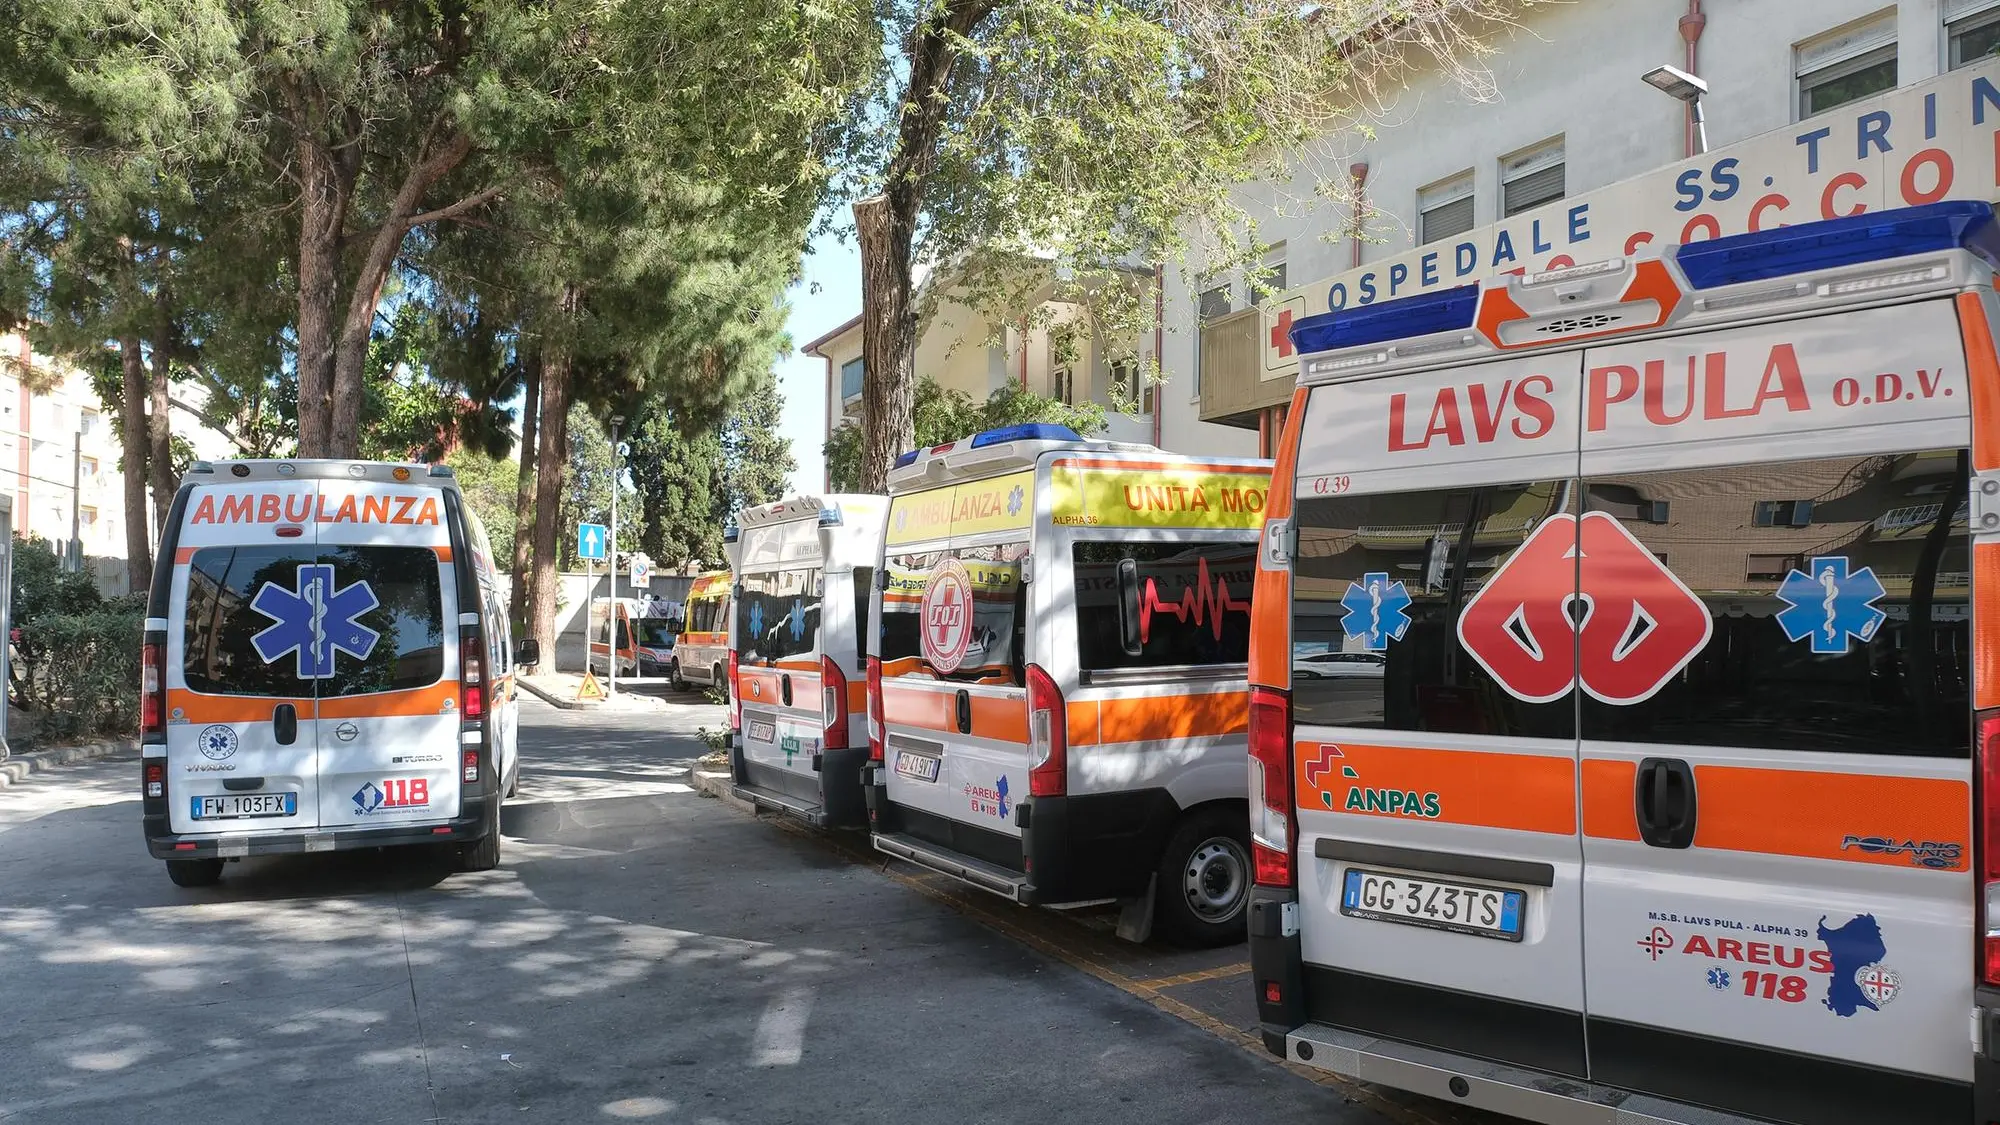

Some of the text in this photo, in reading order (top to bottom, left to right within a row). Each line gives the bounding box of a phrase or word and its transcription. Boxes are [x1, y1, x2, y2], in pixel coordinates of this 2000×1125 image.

[1328, 204, 1590, 313] OSPEDALE
[1388, 374, 1556, 452] LAVS
[1586, 342, 1812, 433] PULA
[1123, 484, 1268, 513] UNITÀ MO
[1331, 475, 1350, 493] 39
[191, 494, 440, 526] AMBULANZA
[909, 492, 1002, 527] AMBULANZA
[1052, 515, 1098, 525] ALPHA 36
[383, 778, 429, 806] 118
[972, 786, 1001, 802] AREUS
[1345, 786, 1441, 818] ANPAS
[986, 805, 997, 816] 118
[1840, 834, 1963, 859] POLARIS
[1648, 911, 1681, 923] M.S.B.
[1684, 916, 1711, 927] LAVS
[1714, 919, 1743, 931] PULA
[1753, 923, 1791, 937] ALPHA
[1794, 928, 1809, 938] 39
[1682, 934, 1836, 974] AREUS
[1741, 970, 1808, 1003] 118
